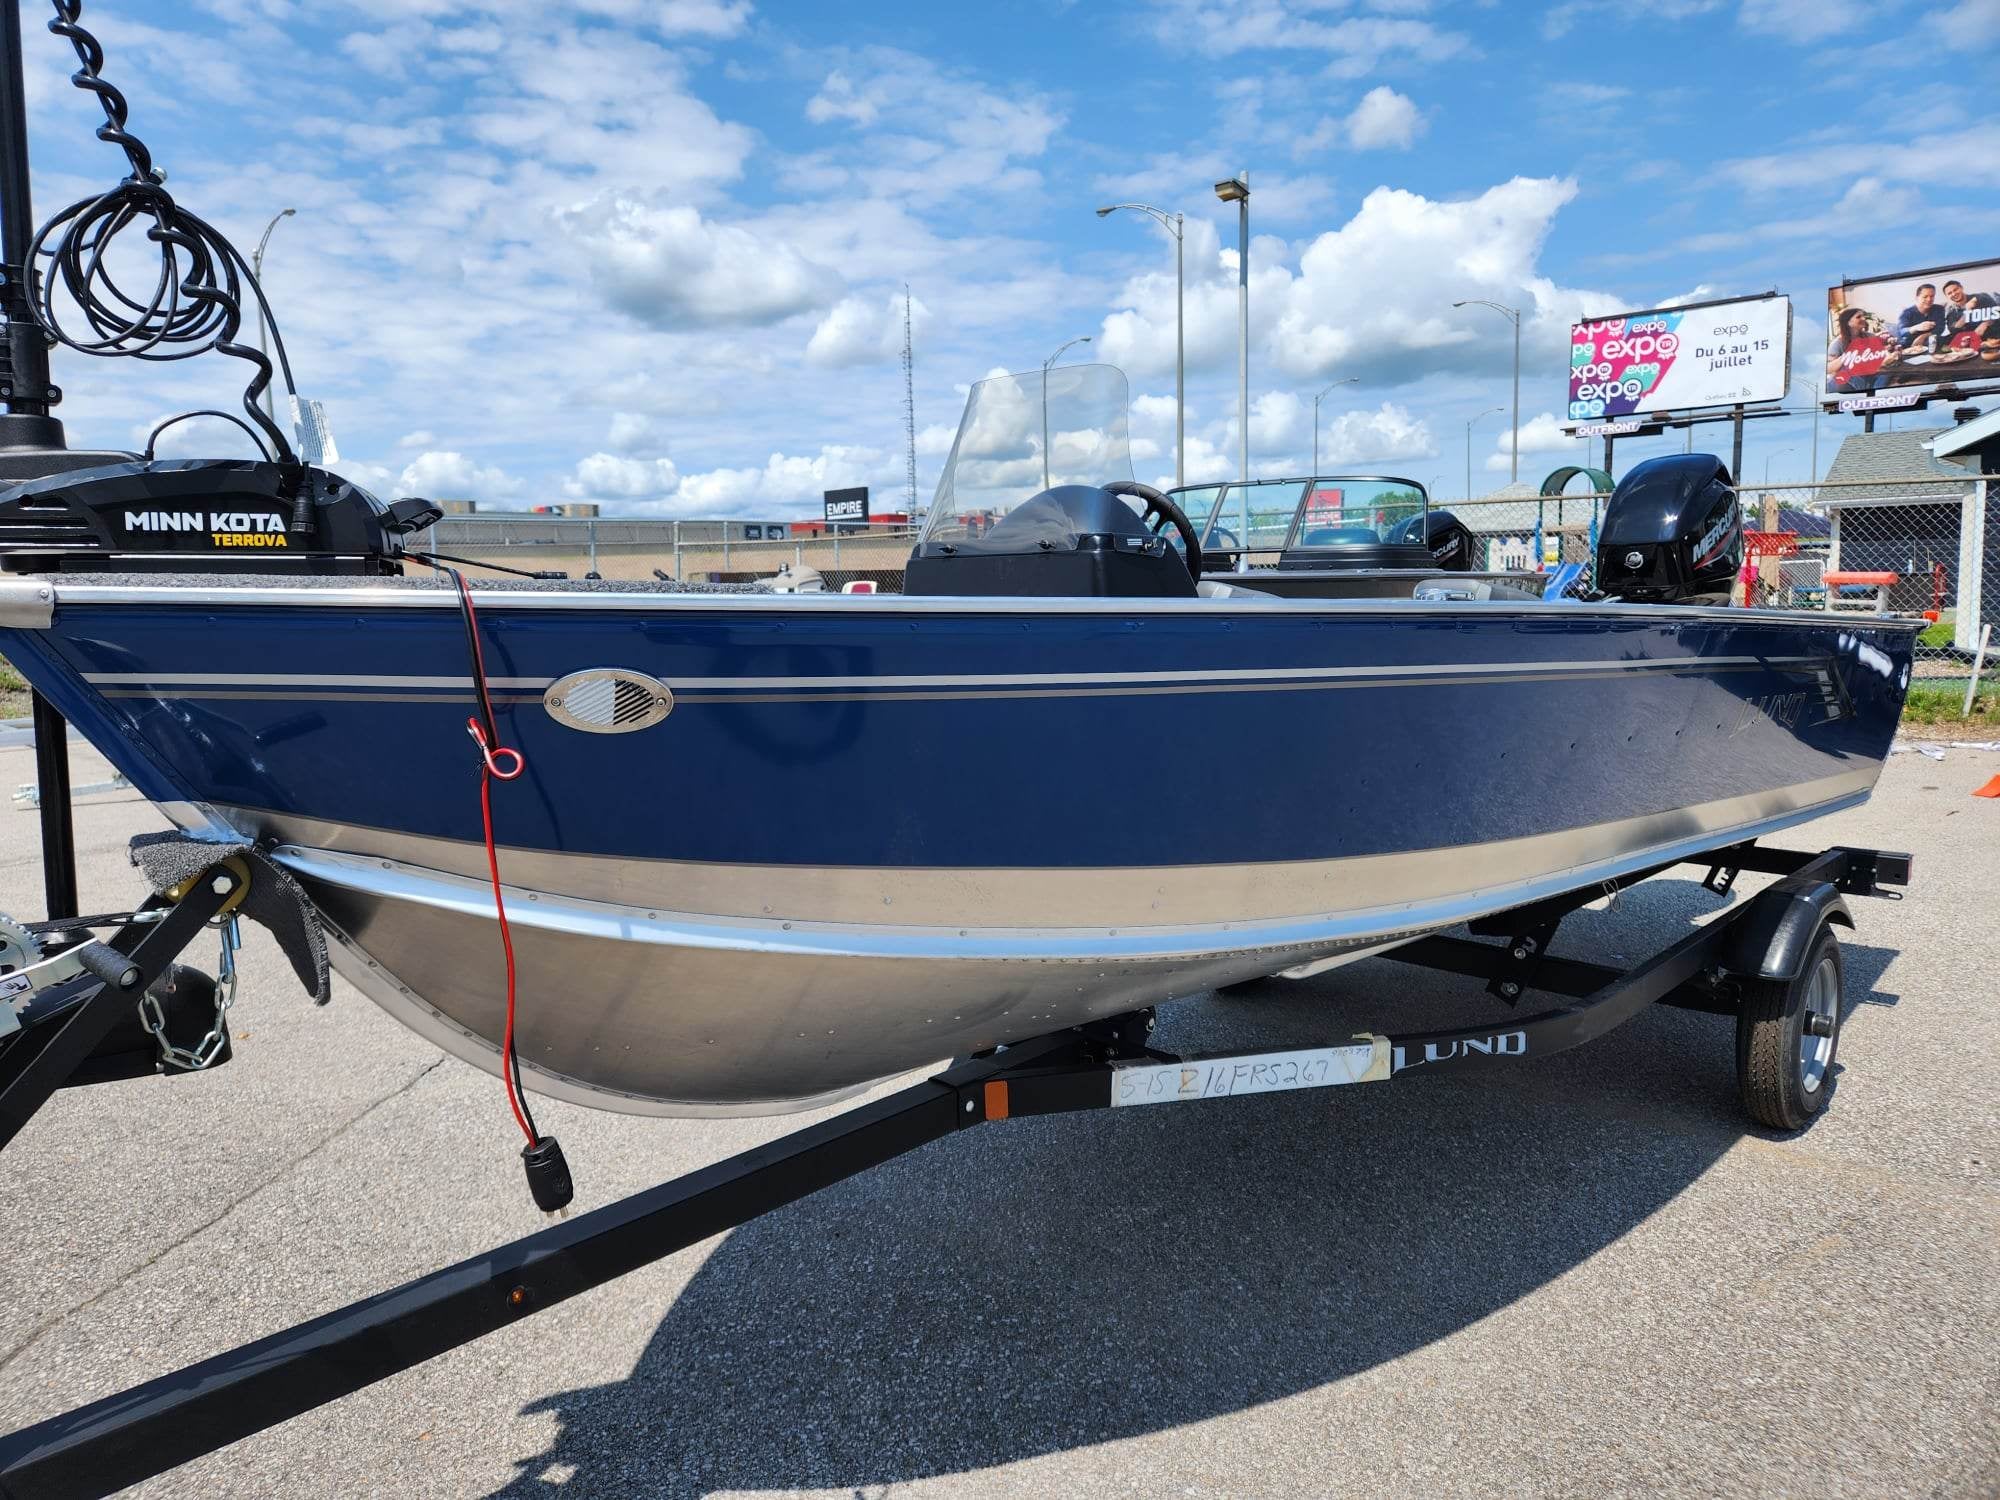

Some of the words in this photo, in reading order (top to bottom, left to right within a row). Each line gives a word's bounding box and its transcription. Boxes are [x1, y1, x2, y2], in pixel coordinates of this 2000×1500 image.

[1964, 305, 2000, 322] TOUS
[1572, 319, 1626, 340] xpo
[1632, 320, 1667, 334] expo
[1714, 324, 1749, 337] expo
[1602, 333, 1678, 363] expo
[1695, 347, 1713, 358] Du
[1718, 344, 1726, 355] 6
[1731, 344, 1748, 354] au
[1753, 339, 1769, 351] 15
[1709, 355, 1752, 372] juillet
[1840, 347, 1890, 369] Molson
[1627, 362, 1660, 376] expo
[1577, 379, 1642, 404] expo
[1842, 394, 1914, 410] OUTFRONT
[1578, 422, 1639, 435] OUTFRONT
[826, 500, 864, 515] EMPIRE
[124, 511, 204, 531] MINN
[209, 513, 287, 532] KOTA
[211, 533, 288, 547] TERROVA
[1391, 1031, 1527, 1076] LUND
